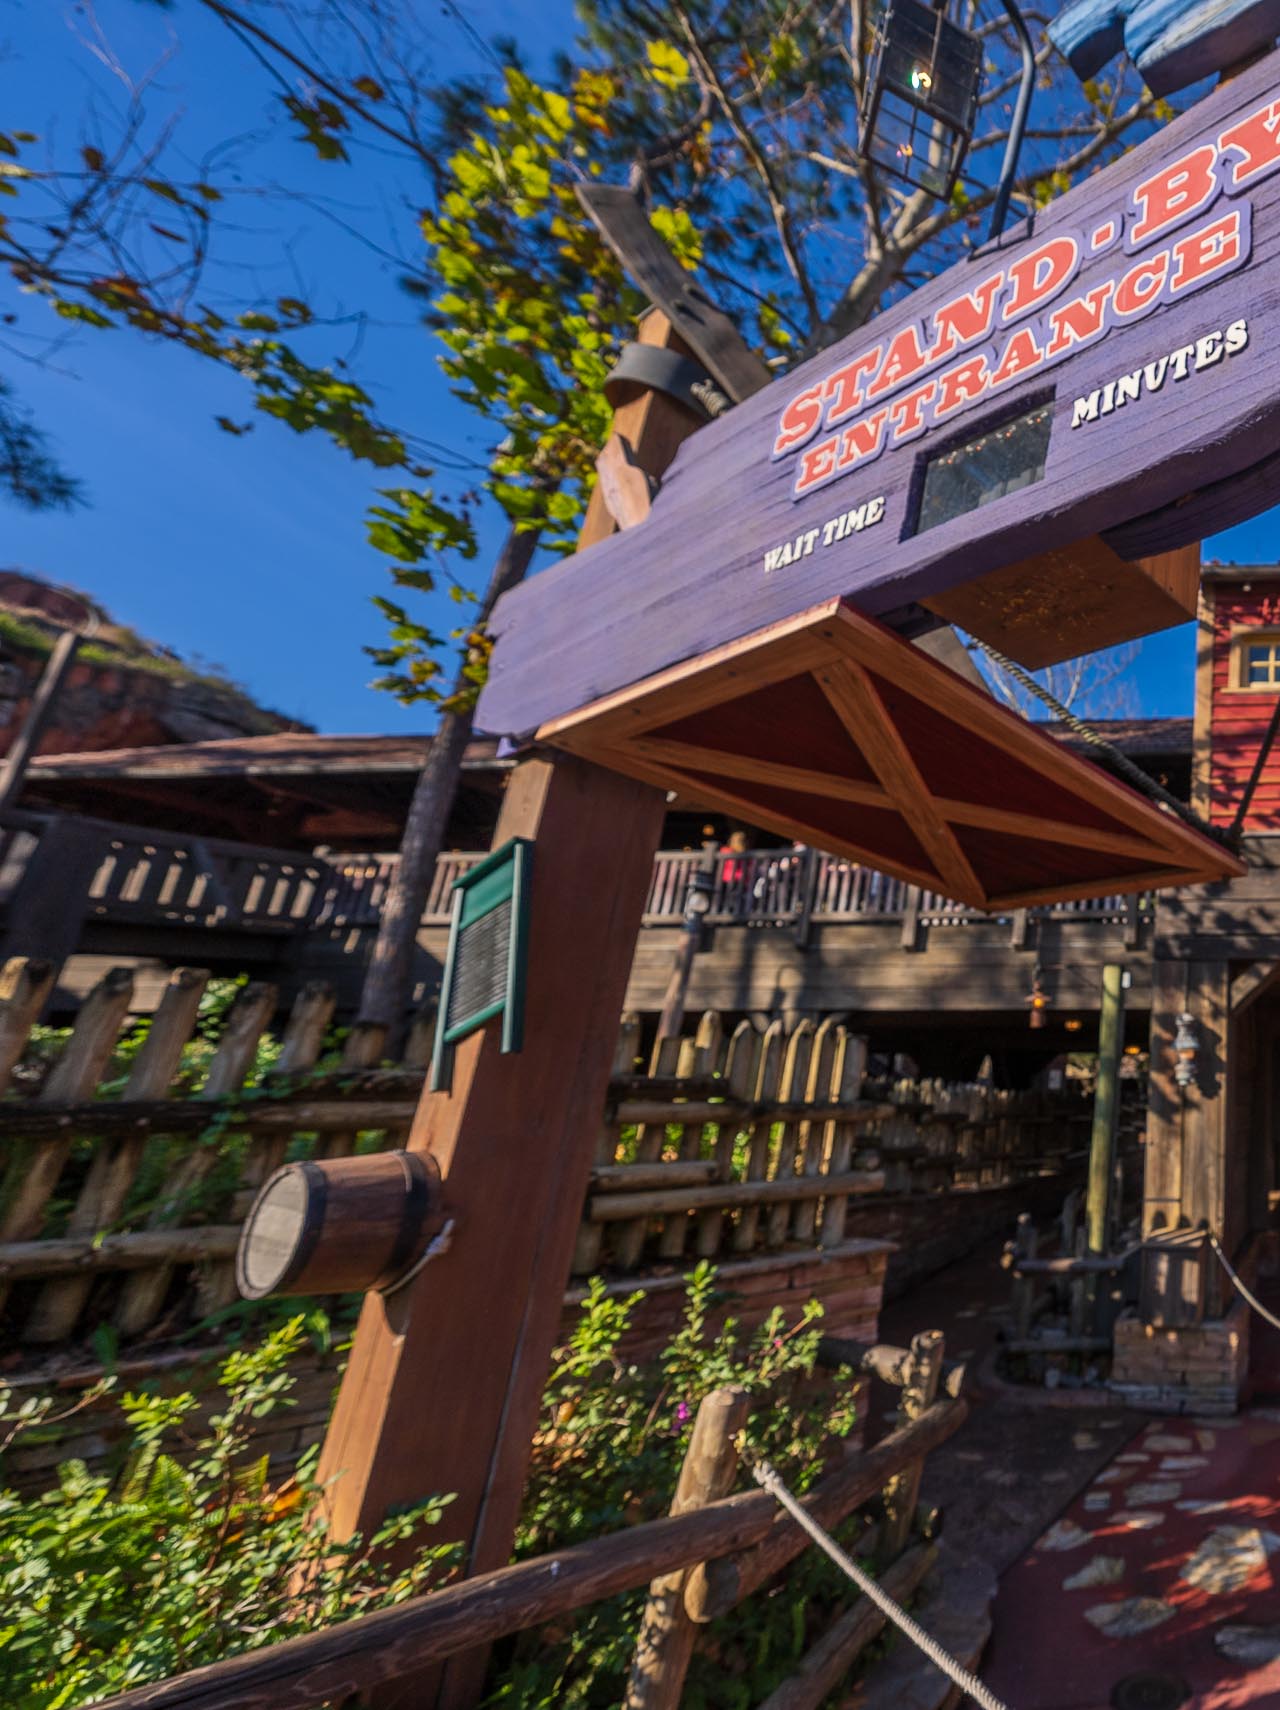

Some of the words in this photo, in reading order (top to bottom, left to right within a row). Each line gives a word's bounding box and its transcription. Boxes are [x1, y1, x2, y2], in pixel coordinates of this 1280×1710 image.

[763, 527, 820, 574] WAIT
[822, 496, 886, 547] TIME
[1070, 318, 1249, 429] MINUTES
[794, 210, 1241, 493] ENTRANCE
